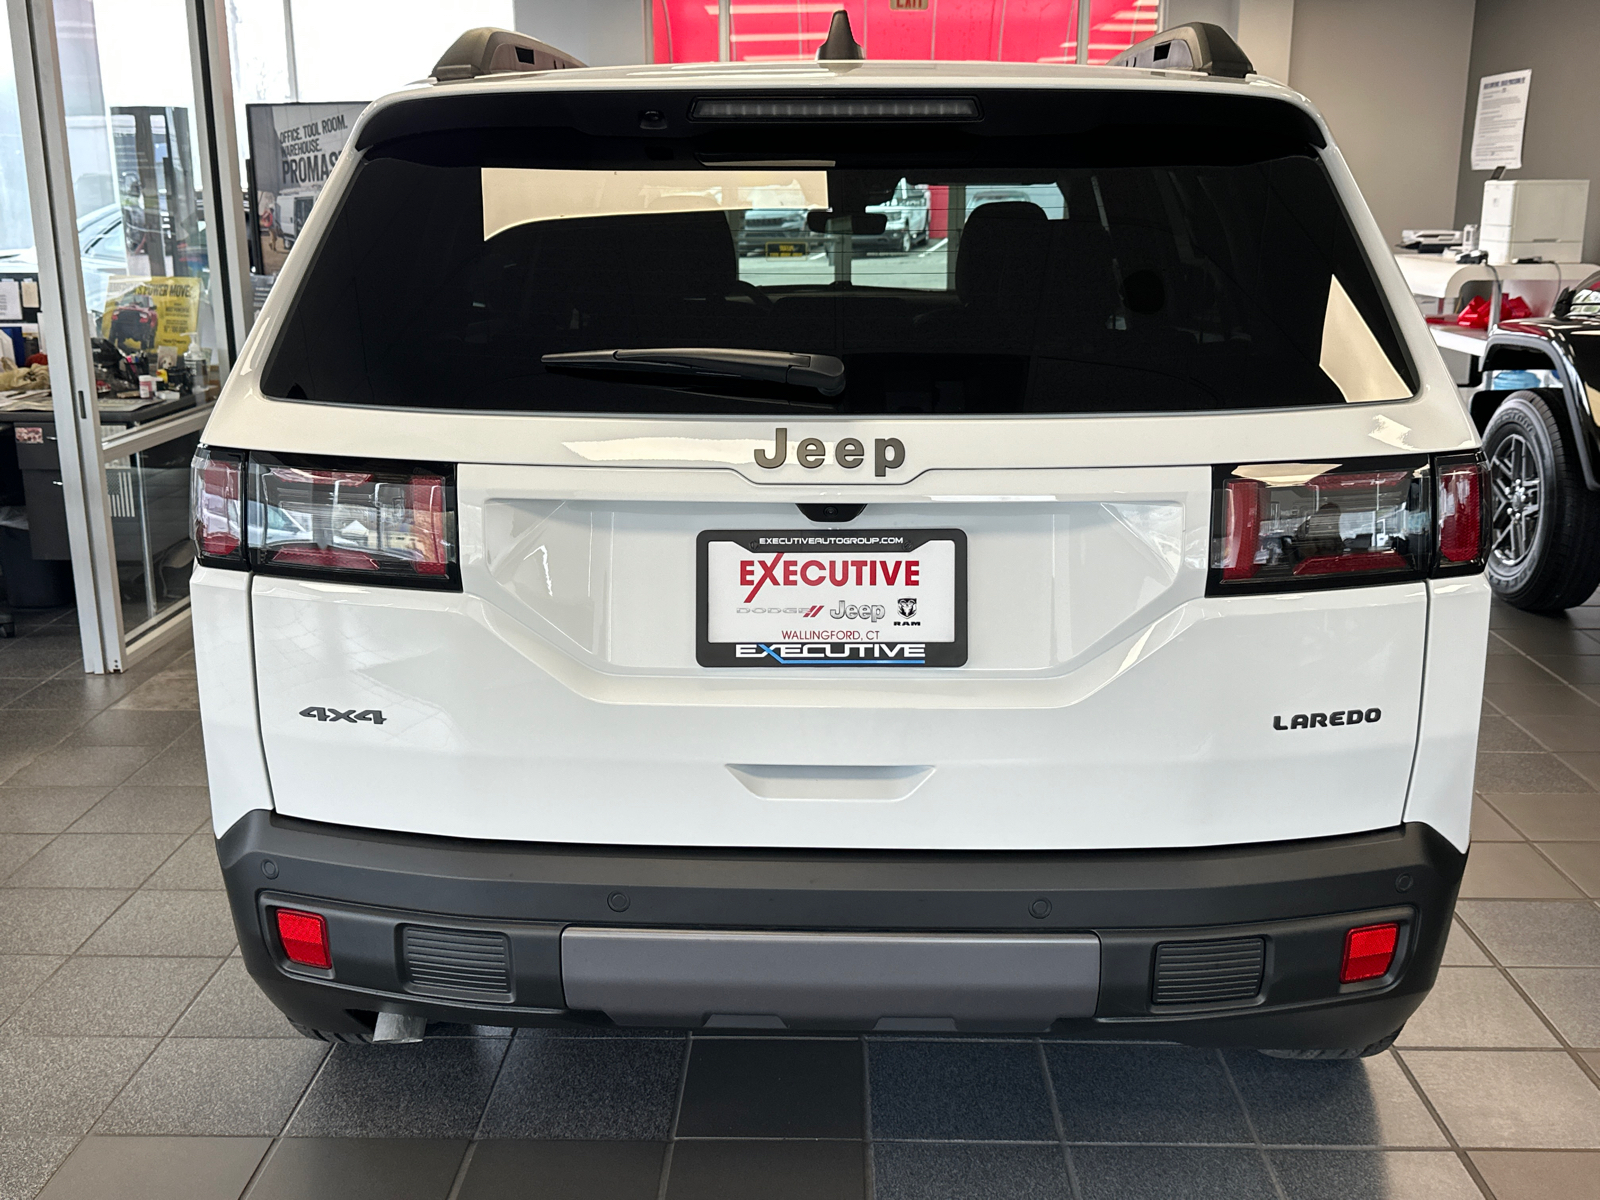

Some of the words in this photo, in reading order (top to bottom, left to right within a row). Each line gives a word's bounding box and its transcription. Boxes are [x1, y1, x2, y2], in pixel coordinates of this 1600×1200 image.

[303, 122, 321, 139] TOOL
[322, 114, 348, 135] ROOM.
[281, 138, 322, 158] WAREHOUSE.
[282, 150, 342, 184] PROMAS
[754, 427, 905, 477] Jeep
[759, 537, 904, 545] EXECUTIVEAUTOGROUP.COM
[740, 552, 920, 603] EXECUTIVE
[736, 606, 813, 615] DODGE
[829, 600, 886, 623] Jeep
[781, 630, 863, 641] WALLINGFORD,
[865, 630, 880, 641] CT
[735, 643, 926, 662] EXECUTIVE
[1273, 707, 1382, 731] LAREDO
